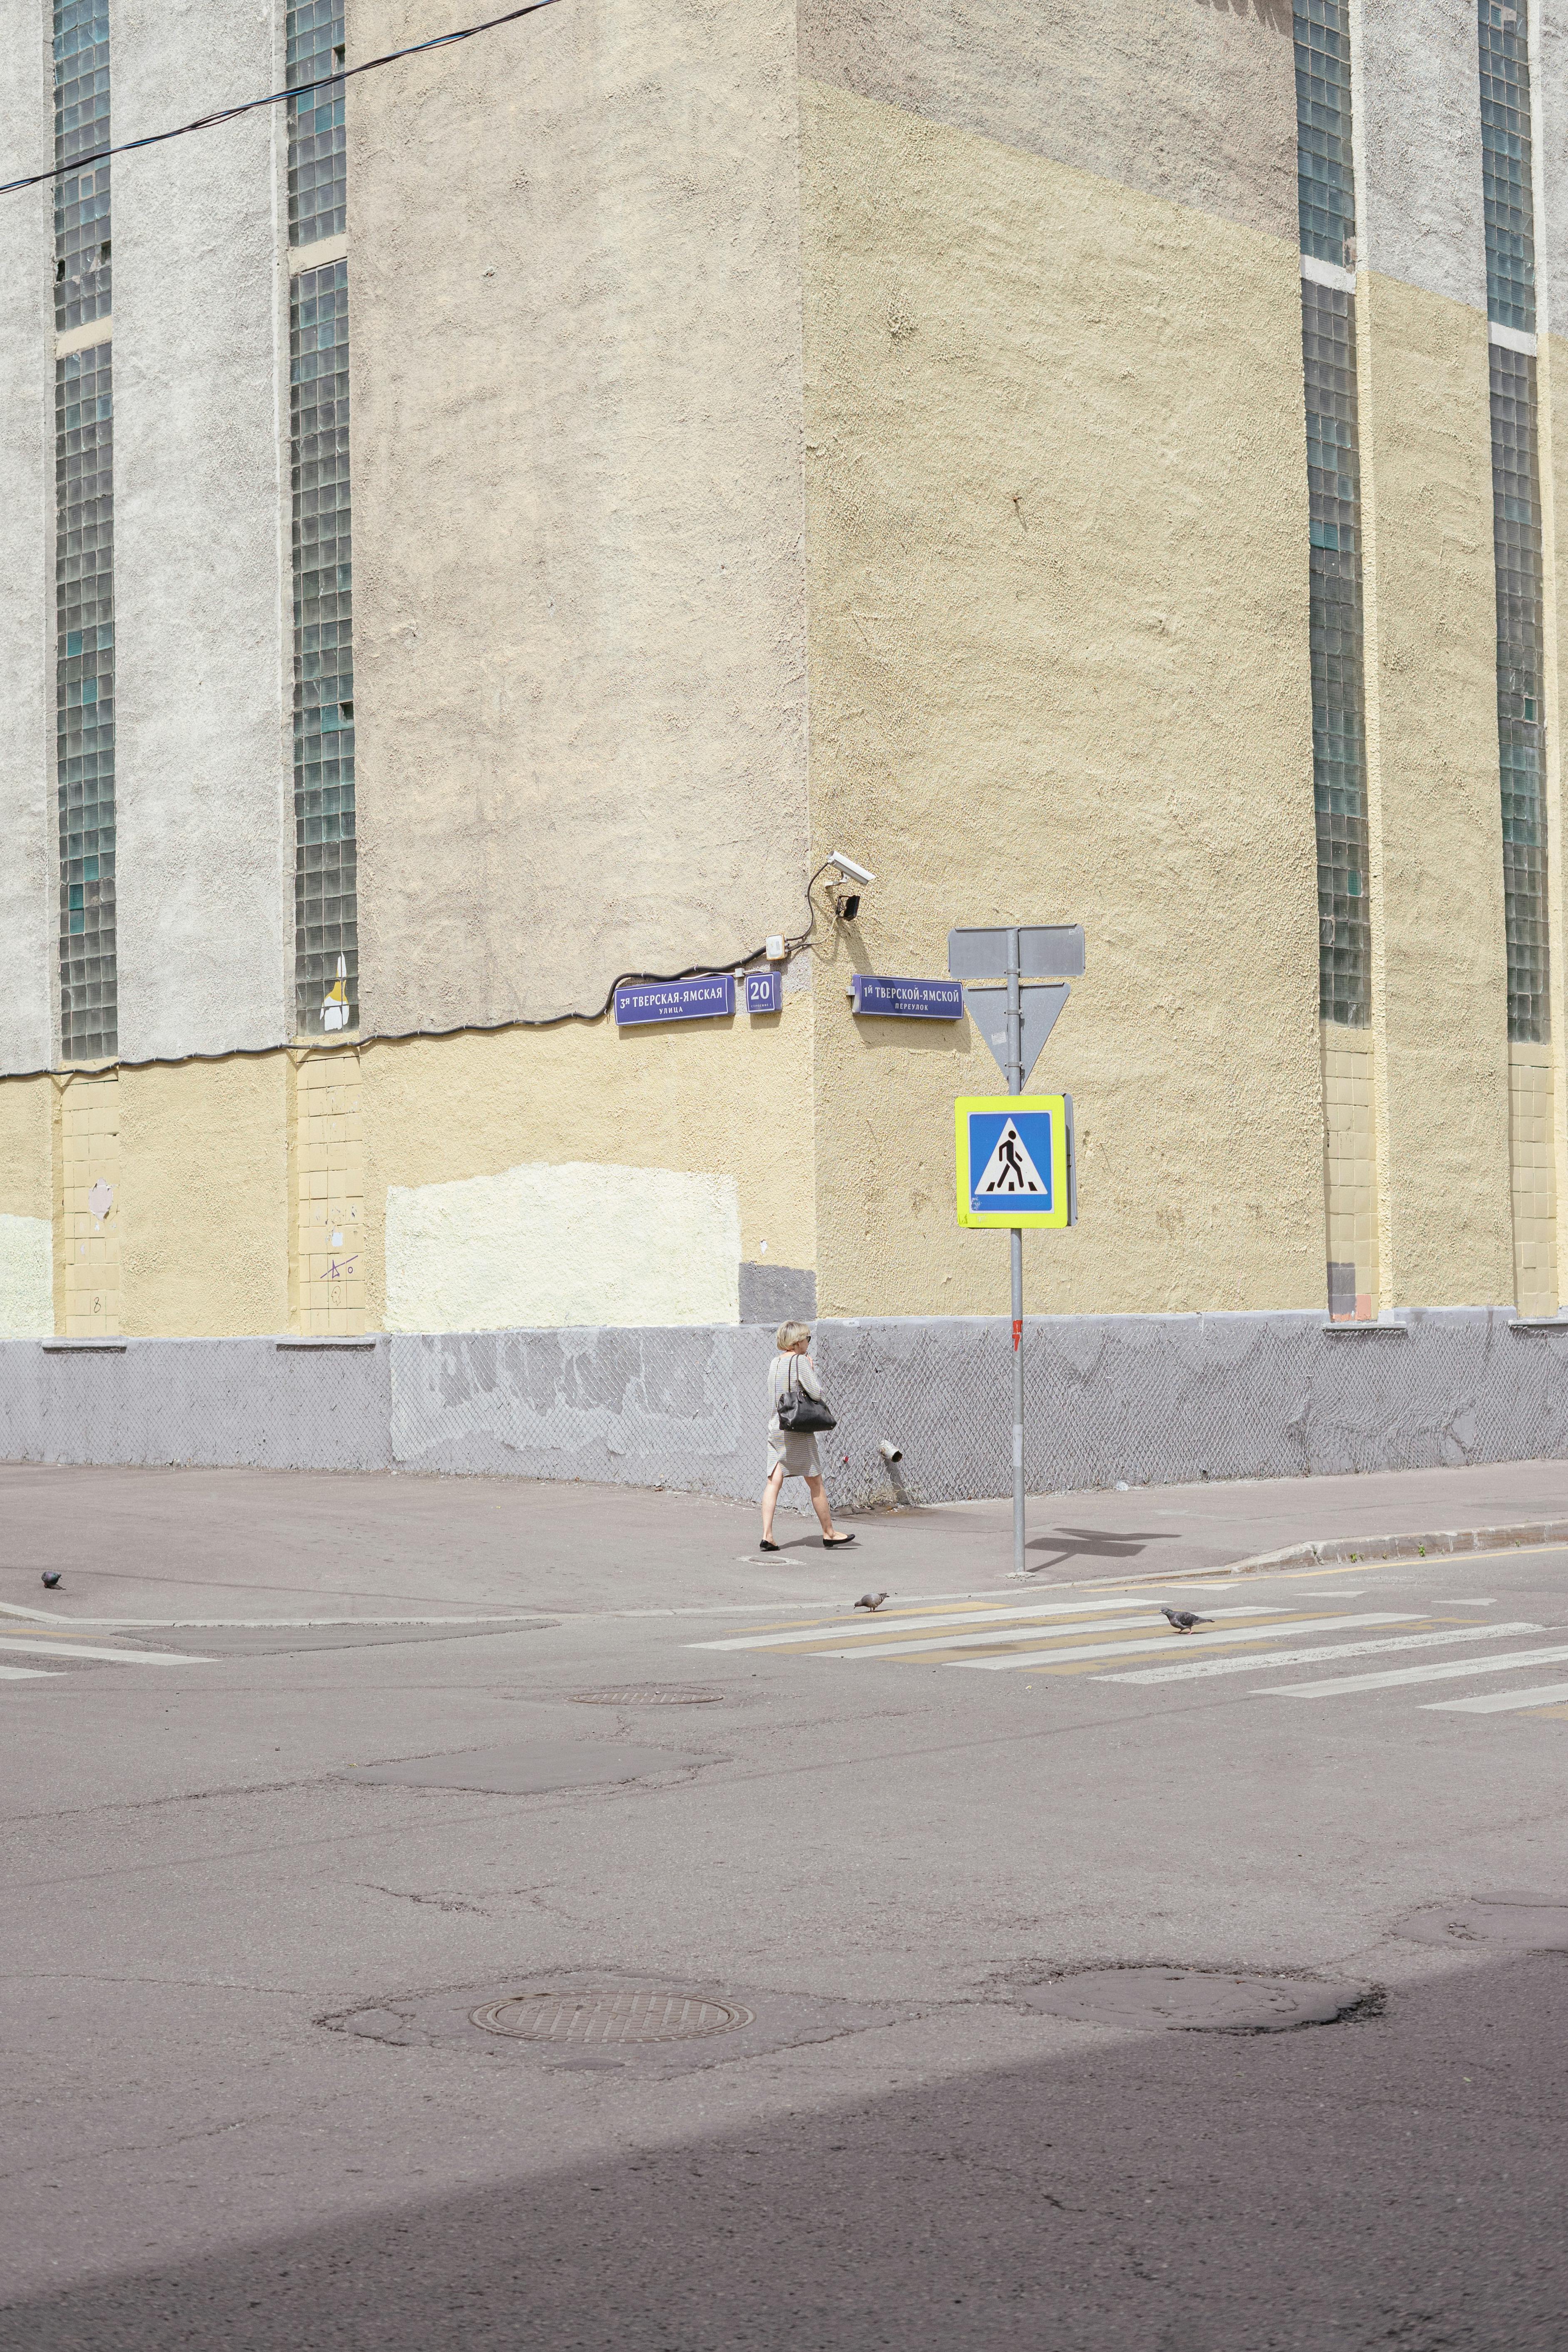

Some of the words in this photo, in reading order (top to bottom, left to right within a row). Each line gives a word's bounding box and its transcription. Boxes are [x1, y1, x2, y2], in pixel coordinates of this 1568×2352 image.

[632, 987, 722, 1007] ТВЕРСКАЯ-ЯМСКАЯ
[750, 981, 769, 1000] 20
[875, 987, 959, 1002] ТВЕРСКОЙ-ЯМСКОЙ
